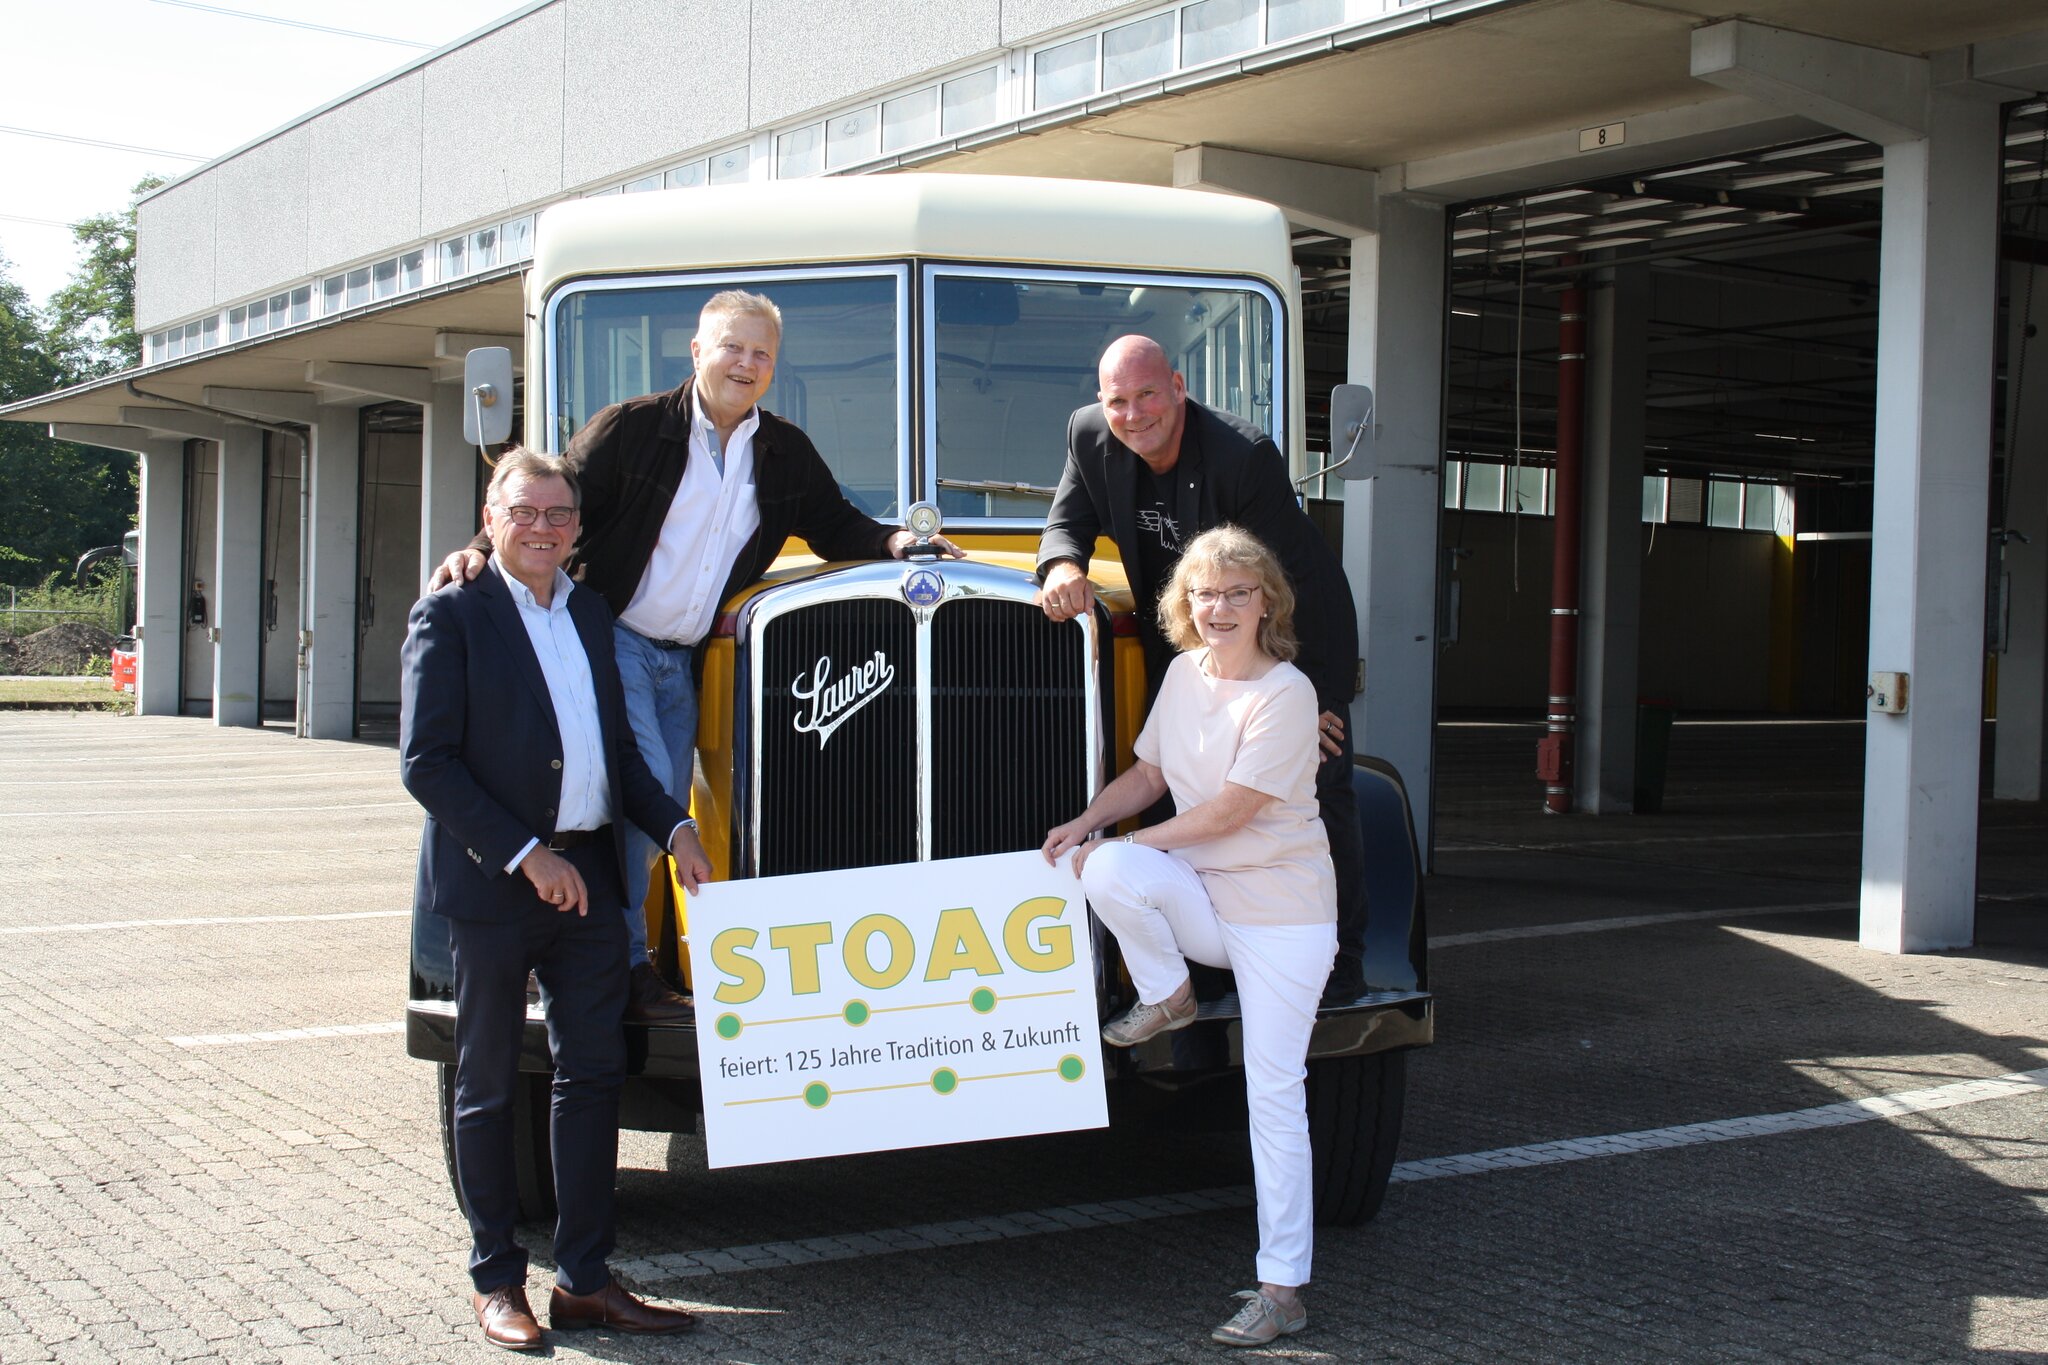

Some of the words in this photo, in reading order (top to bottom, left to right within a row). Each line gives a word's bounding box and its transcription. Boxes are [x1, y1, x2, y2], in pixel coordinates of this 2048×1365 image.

[1599, 128, 1606, 145] 8
[710, 896, 1075, 1005] STOAG
[720, 1057, 779, 1078] feiert:
[785, 1050, 822, 1072] 125
[830, 1045, 882, 1068] Jahre
[885, 1037, 974, 1061] Tradition
[982, 1031, 996, 1051] &
[1003, 1022, 1080, 1050] Zukunft
